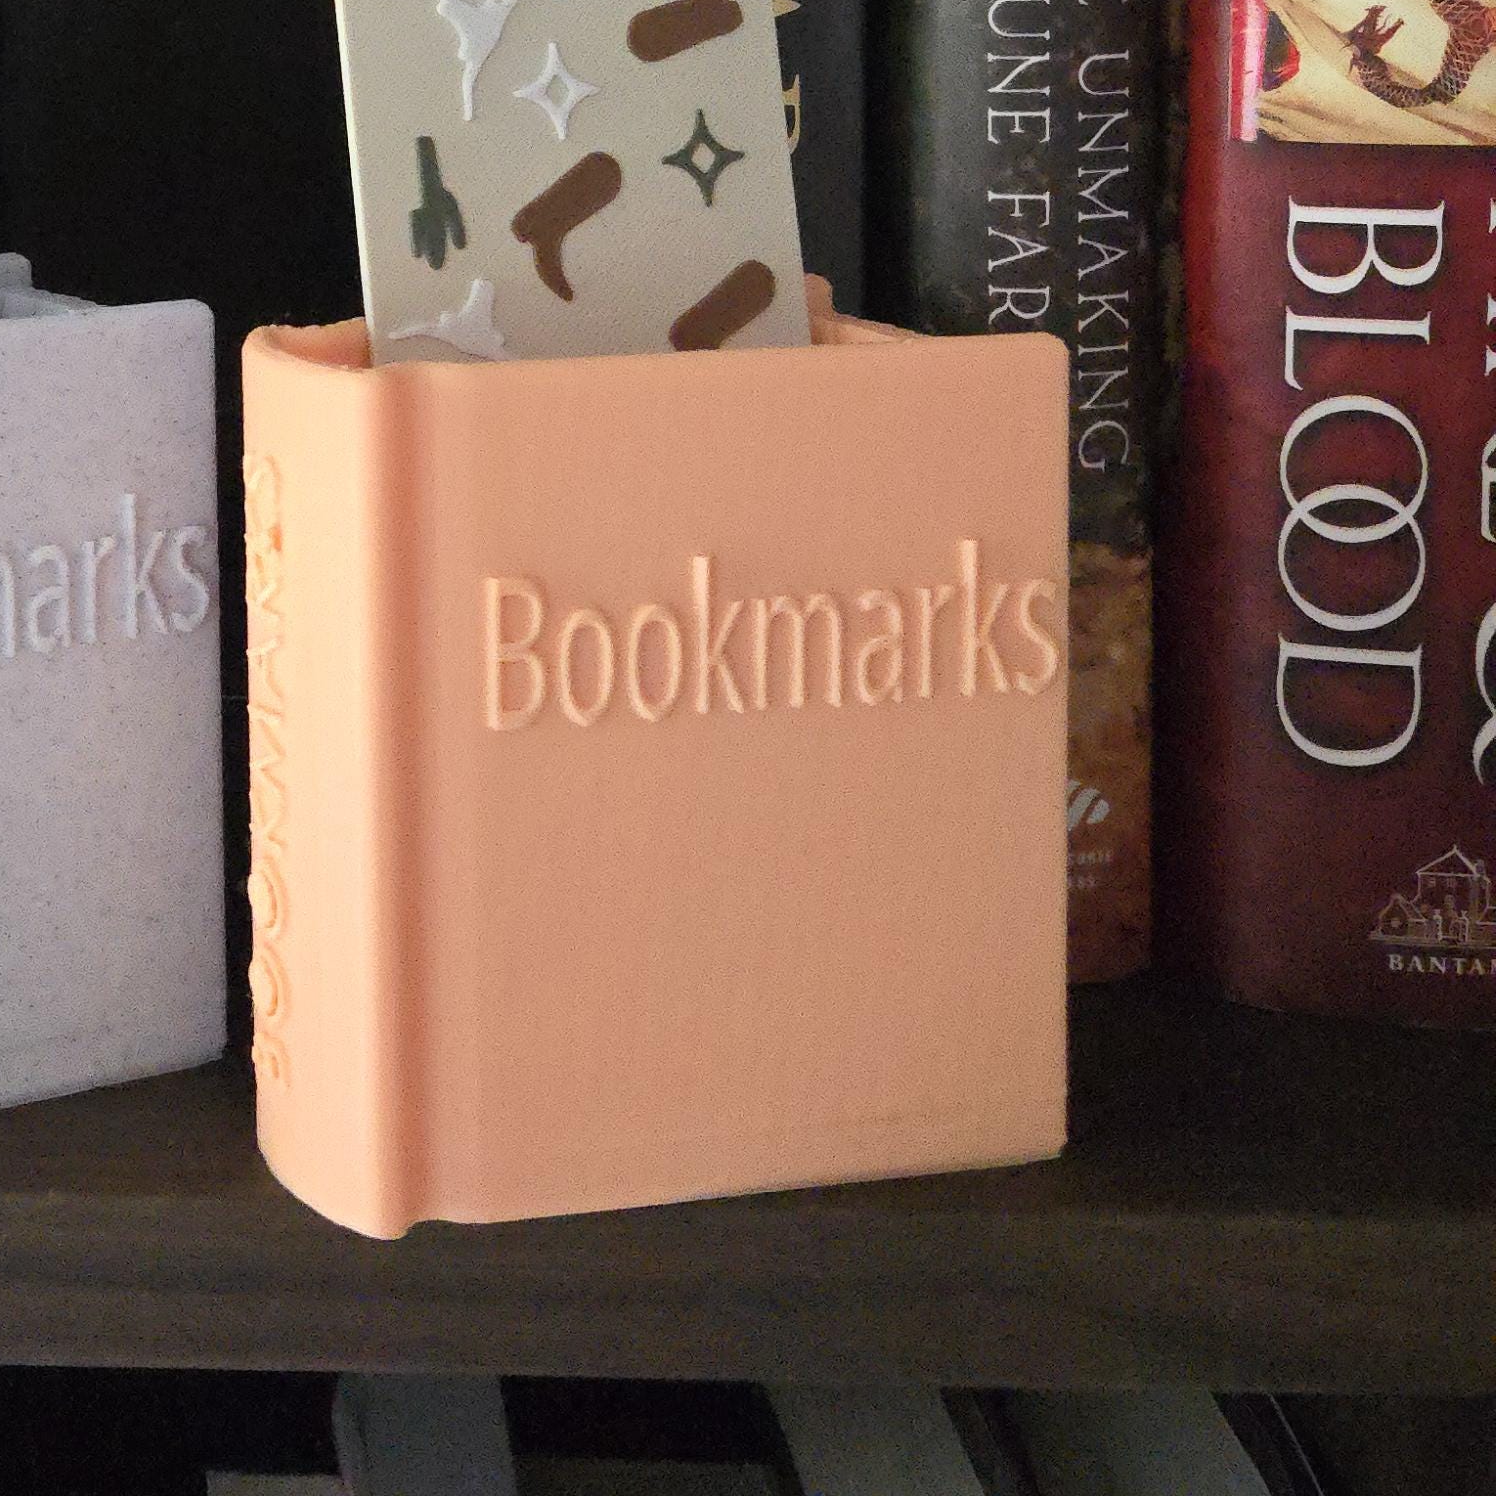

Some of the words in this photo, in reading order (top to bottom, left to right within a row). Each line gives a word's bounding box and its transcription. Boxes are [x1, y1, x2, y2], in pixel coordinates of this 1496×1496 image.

[987, 189, 1052, 324] FAR
[1076, 49, 1131, 474] UNMAKING
[1276, 195, 1445, 768] BLOOD
[483, 537, 1060, 731] Bookmarks
[1387, 953, 1496, 977] BANTA
